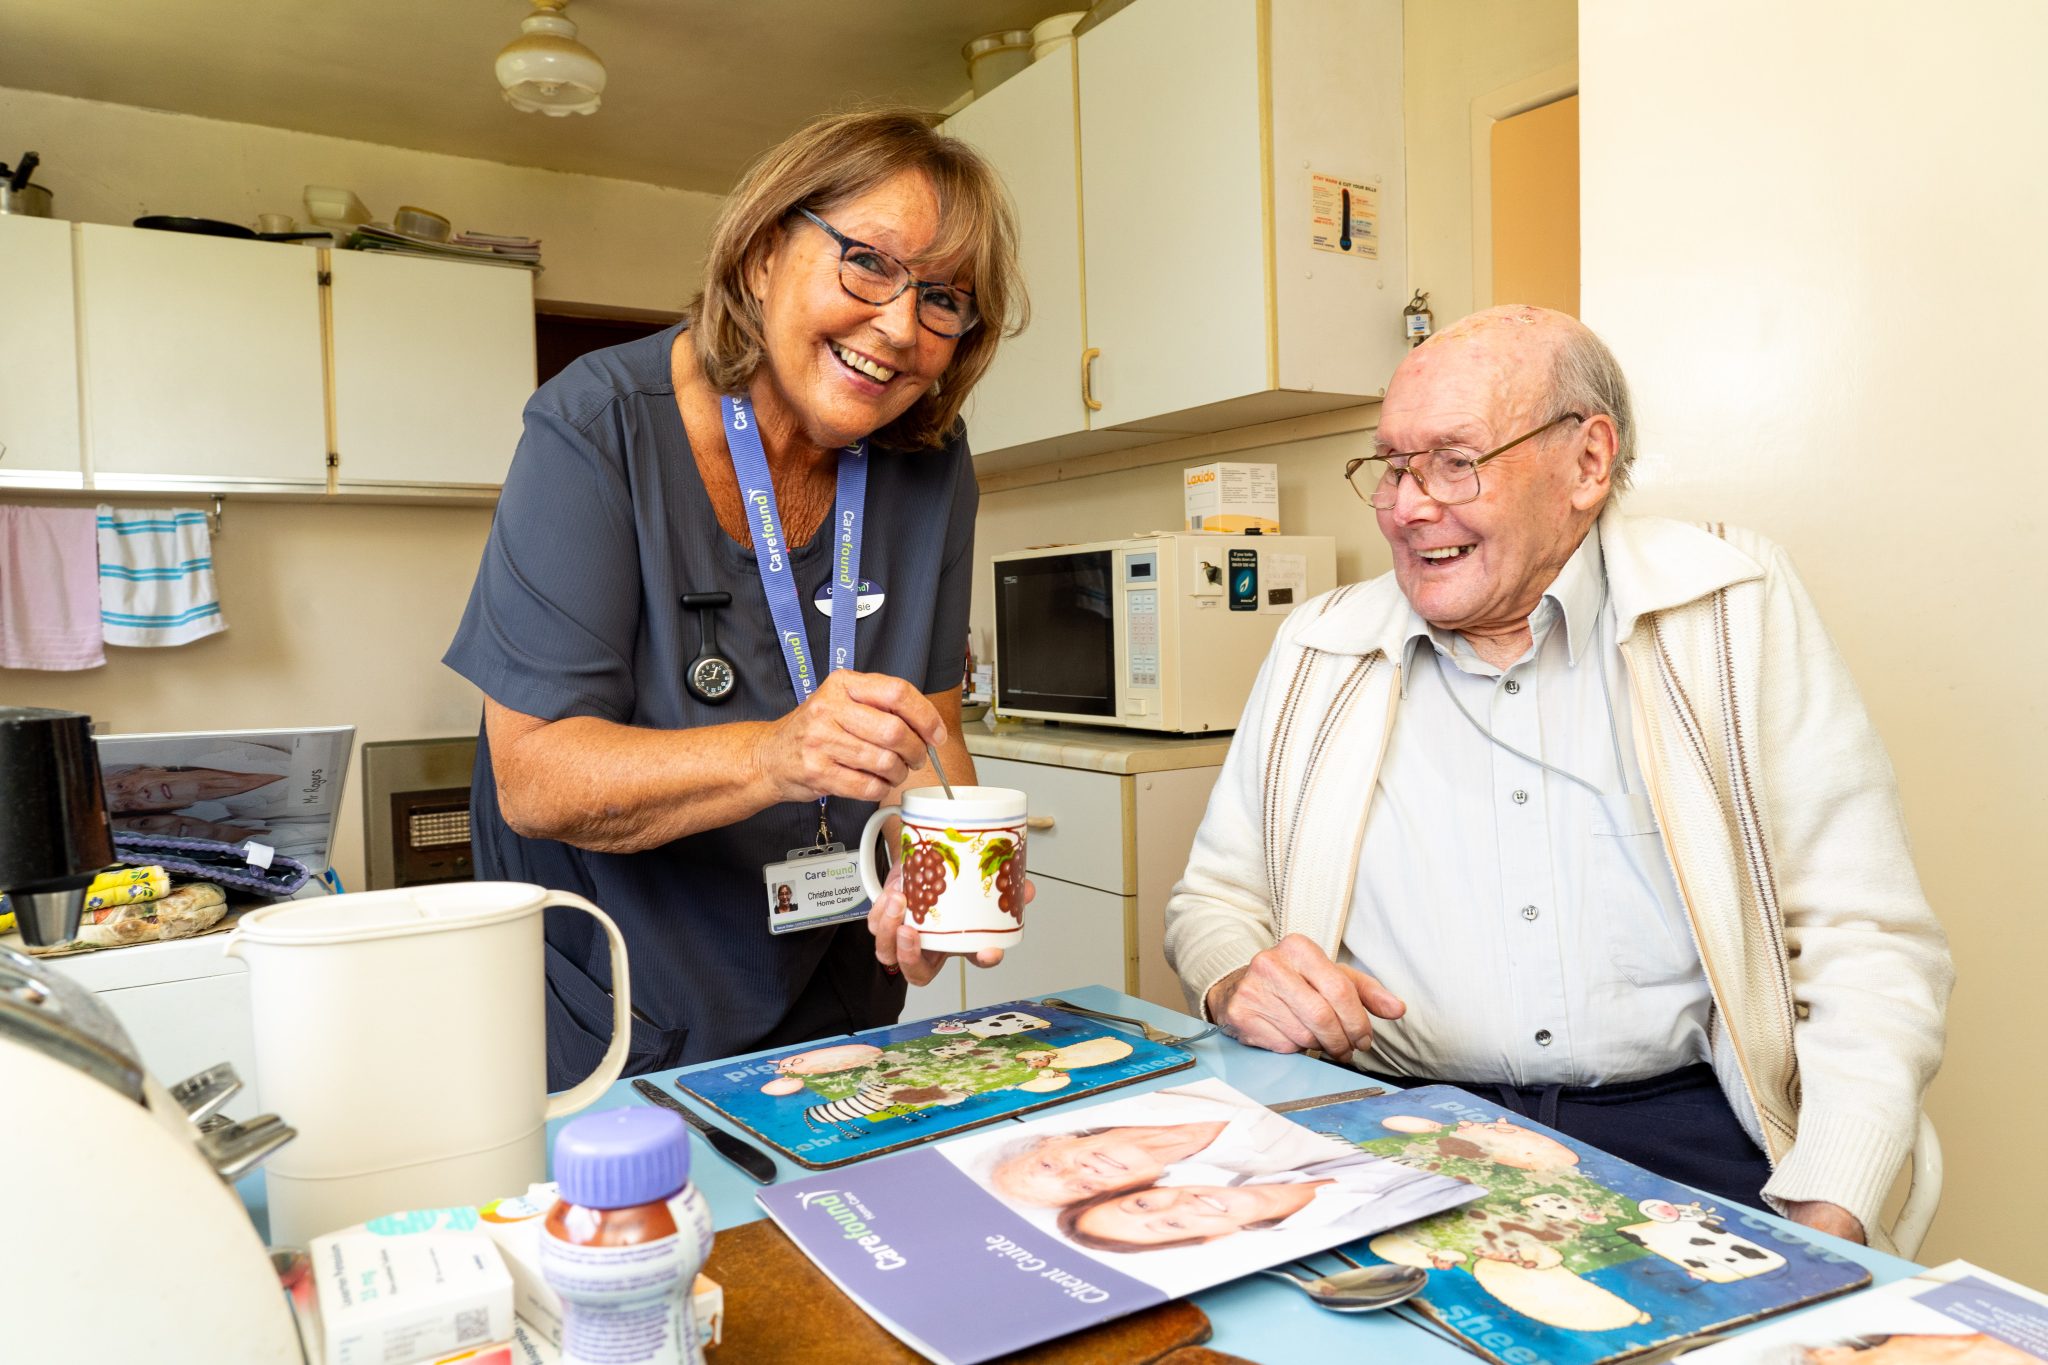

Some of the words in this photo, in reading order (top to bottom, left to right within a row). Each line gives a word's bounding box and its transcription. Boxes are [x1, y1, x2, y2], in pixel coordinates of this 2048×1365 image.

[1186, 470, 1216, 485] Laxido
[752, 494, 784, 573] Carefound
[839, 509, 856, 584] Carefound
[805, 864, 854, 881] Carefound
[807, 889, 834, 901] Christine
[834, 885, 861, 896] Lockyear
[816, 899, 835, 907] Home
[836, 896, 853, 904] Carer
[843, 1191, 860, 1207] Care
[858, 1202, 876, 1222] Home
[811, 1193, 907, 1271] Carefound
[985, 1234, 1047, 1273] Guide
[1041, 1267, 1111, 1305] Client
[1448, 1304, 1552, 1365] shee
